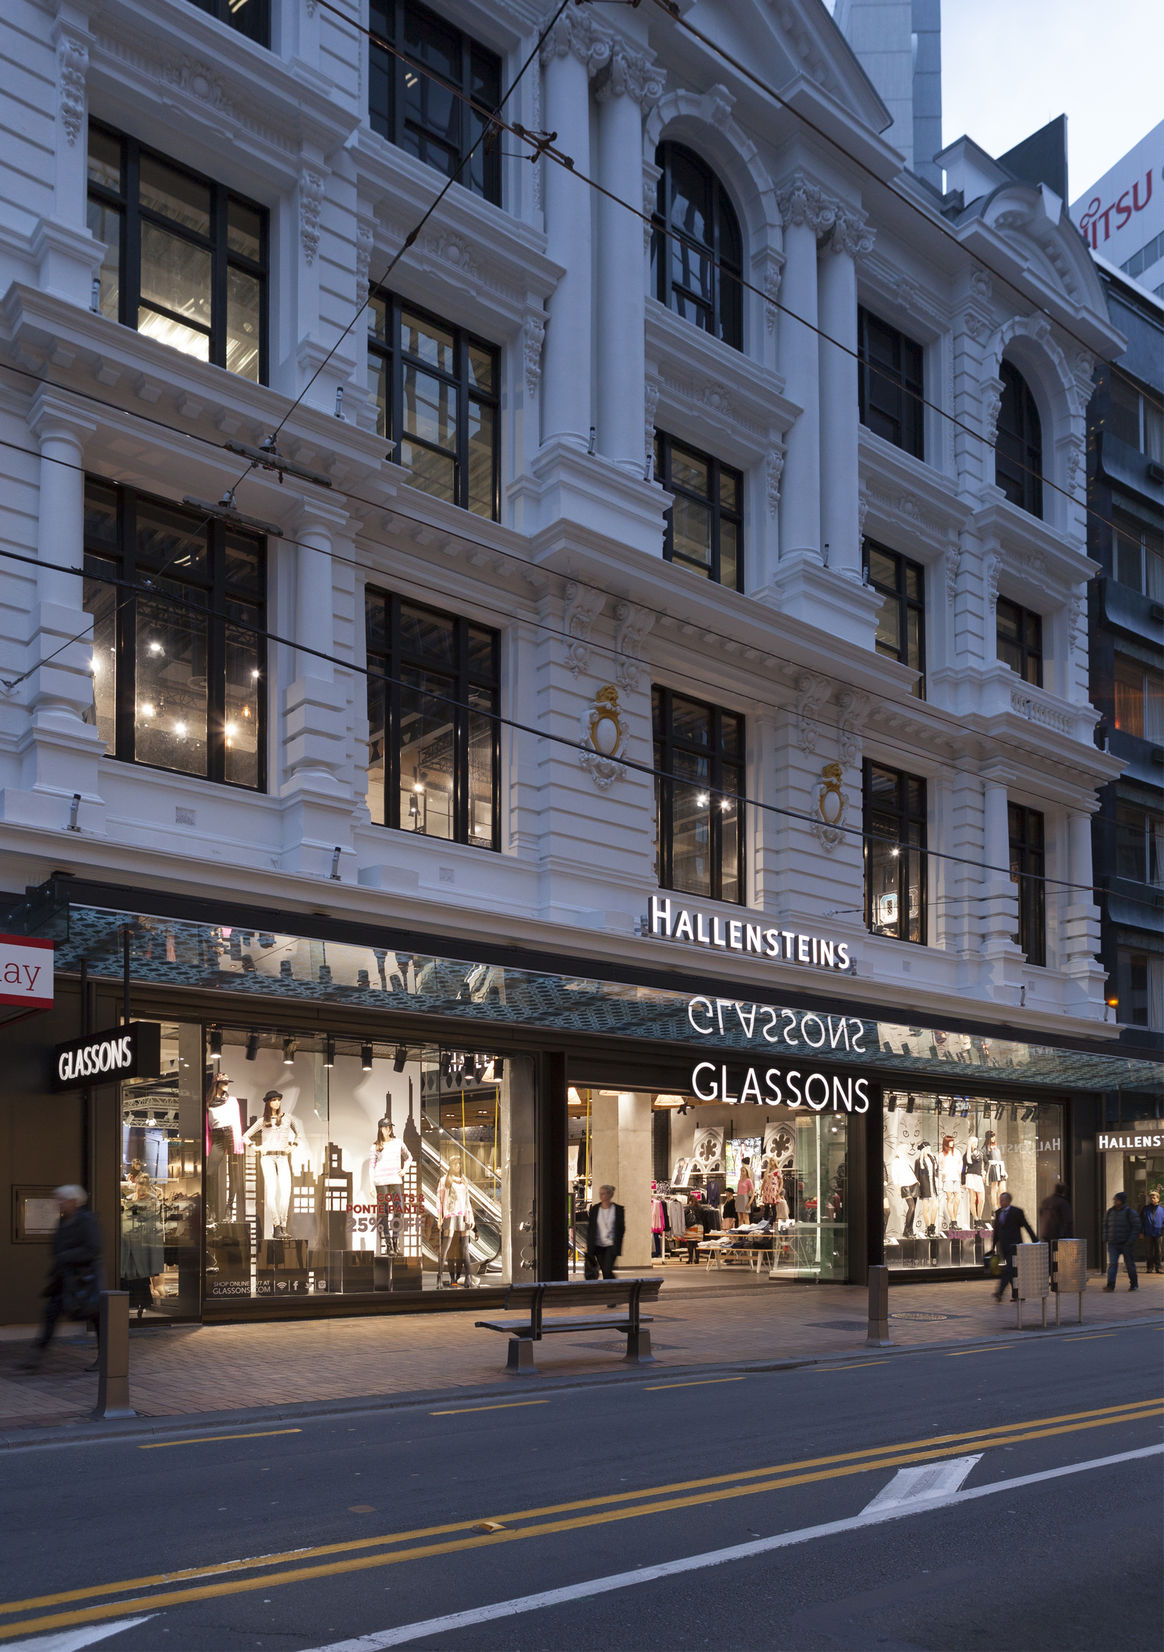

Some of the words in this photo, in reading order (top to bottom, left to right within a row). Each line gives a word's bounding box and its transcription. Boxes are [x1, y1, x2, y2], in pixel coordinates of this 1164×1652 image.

[650, 896, 850, 971] HALLENSTEINS
[0, 962, 42, 992] ay
[58, 1036, 132, 1081] GLASSONS
[691, 1061, 870, 1114] GLASSONS
[346, 1204, 385, 1214] PONTE
[388, 1204, 425, 1214] PANTS
[377, 1193, 415, 1203] COATS
[418, 1193, 425, 1202] &
[346, 1217, 385, 1233] 25%
[391, 1217, 426, 1232] OFF
